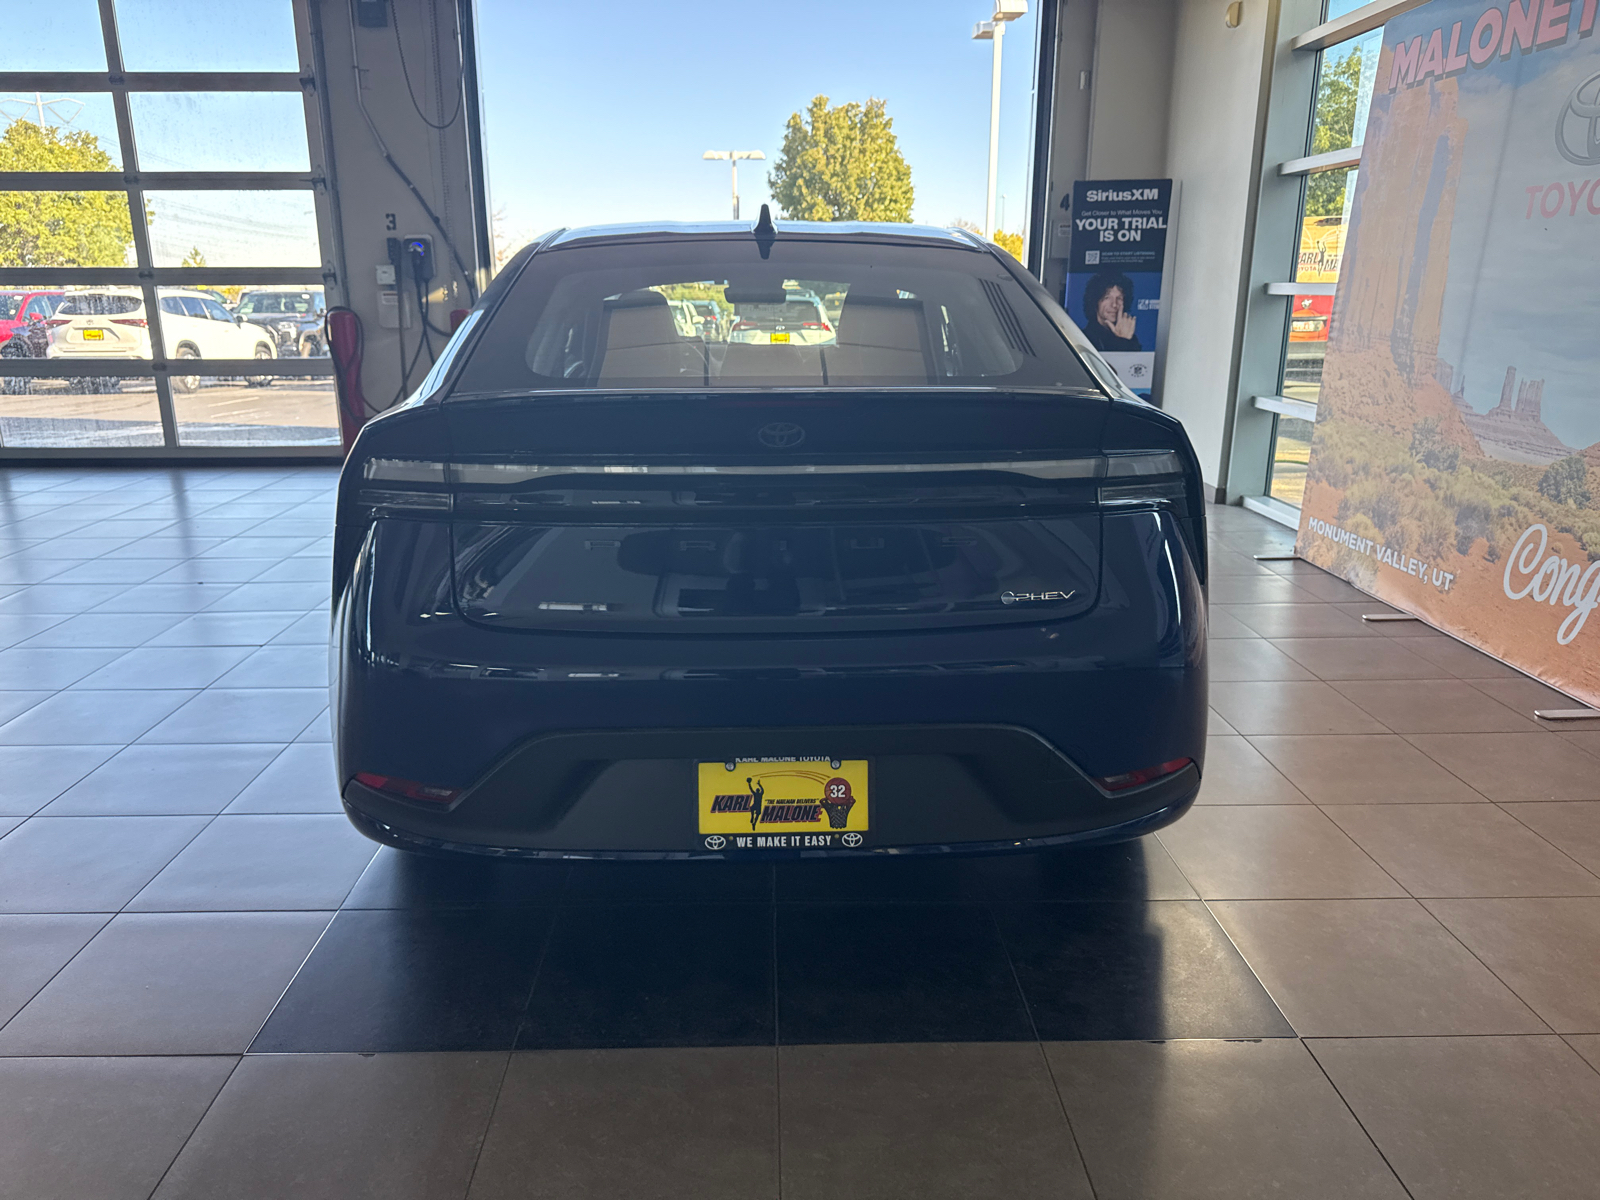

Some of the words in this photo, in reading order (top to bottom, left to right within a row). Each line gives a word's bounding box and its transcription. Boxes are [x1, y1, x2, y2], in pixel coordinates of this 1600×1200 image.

[1388, 0, 1571, 94] MALONE
[1060, 193, 1070, 211] 4
[1086, 188, 1159, 202] SiriusXM
[385, 213, 397, 231] 3
[1075, 217, 1118, 231] YOUR
[1121, 216, 1167, 230] TRIAL
[1099, 230, 1114, 242] IS
[1117, 229, 1142, 242] ON
[1308, 517, 1374, 556] MONUMENT
[1376, 544, 1428, 584] VALLEY,
[1432, 569, 1454, 591] UT
[1015, 590, 1076, 602] PHEV
[830, 784, 846, 798] 32
[710, 794, 753, 813] KARL
[760, 804, 823, 824] MALONE
[736, 836, 753, 848] WE
[757, 836, 787, 847] MAKE
[791, 835, 801, 847] IT
[804, 835, 832, 847] EASY
